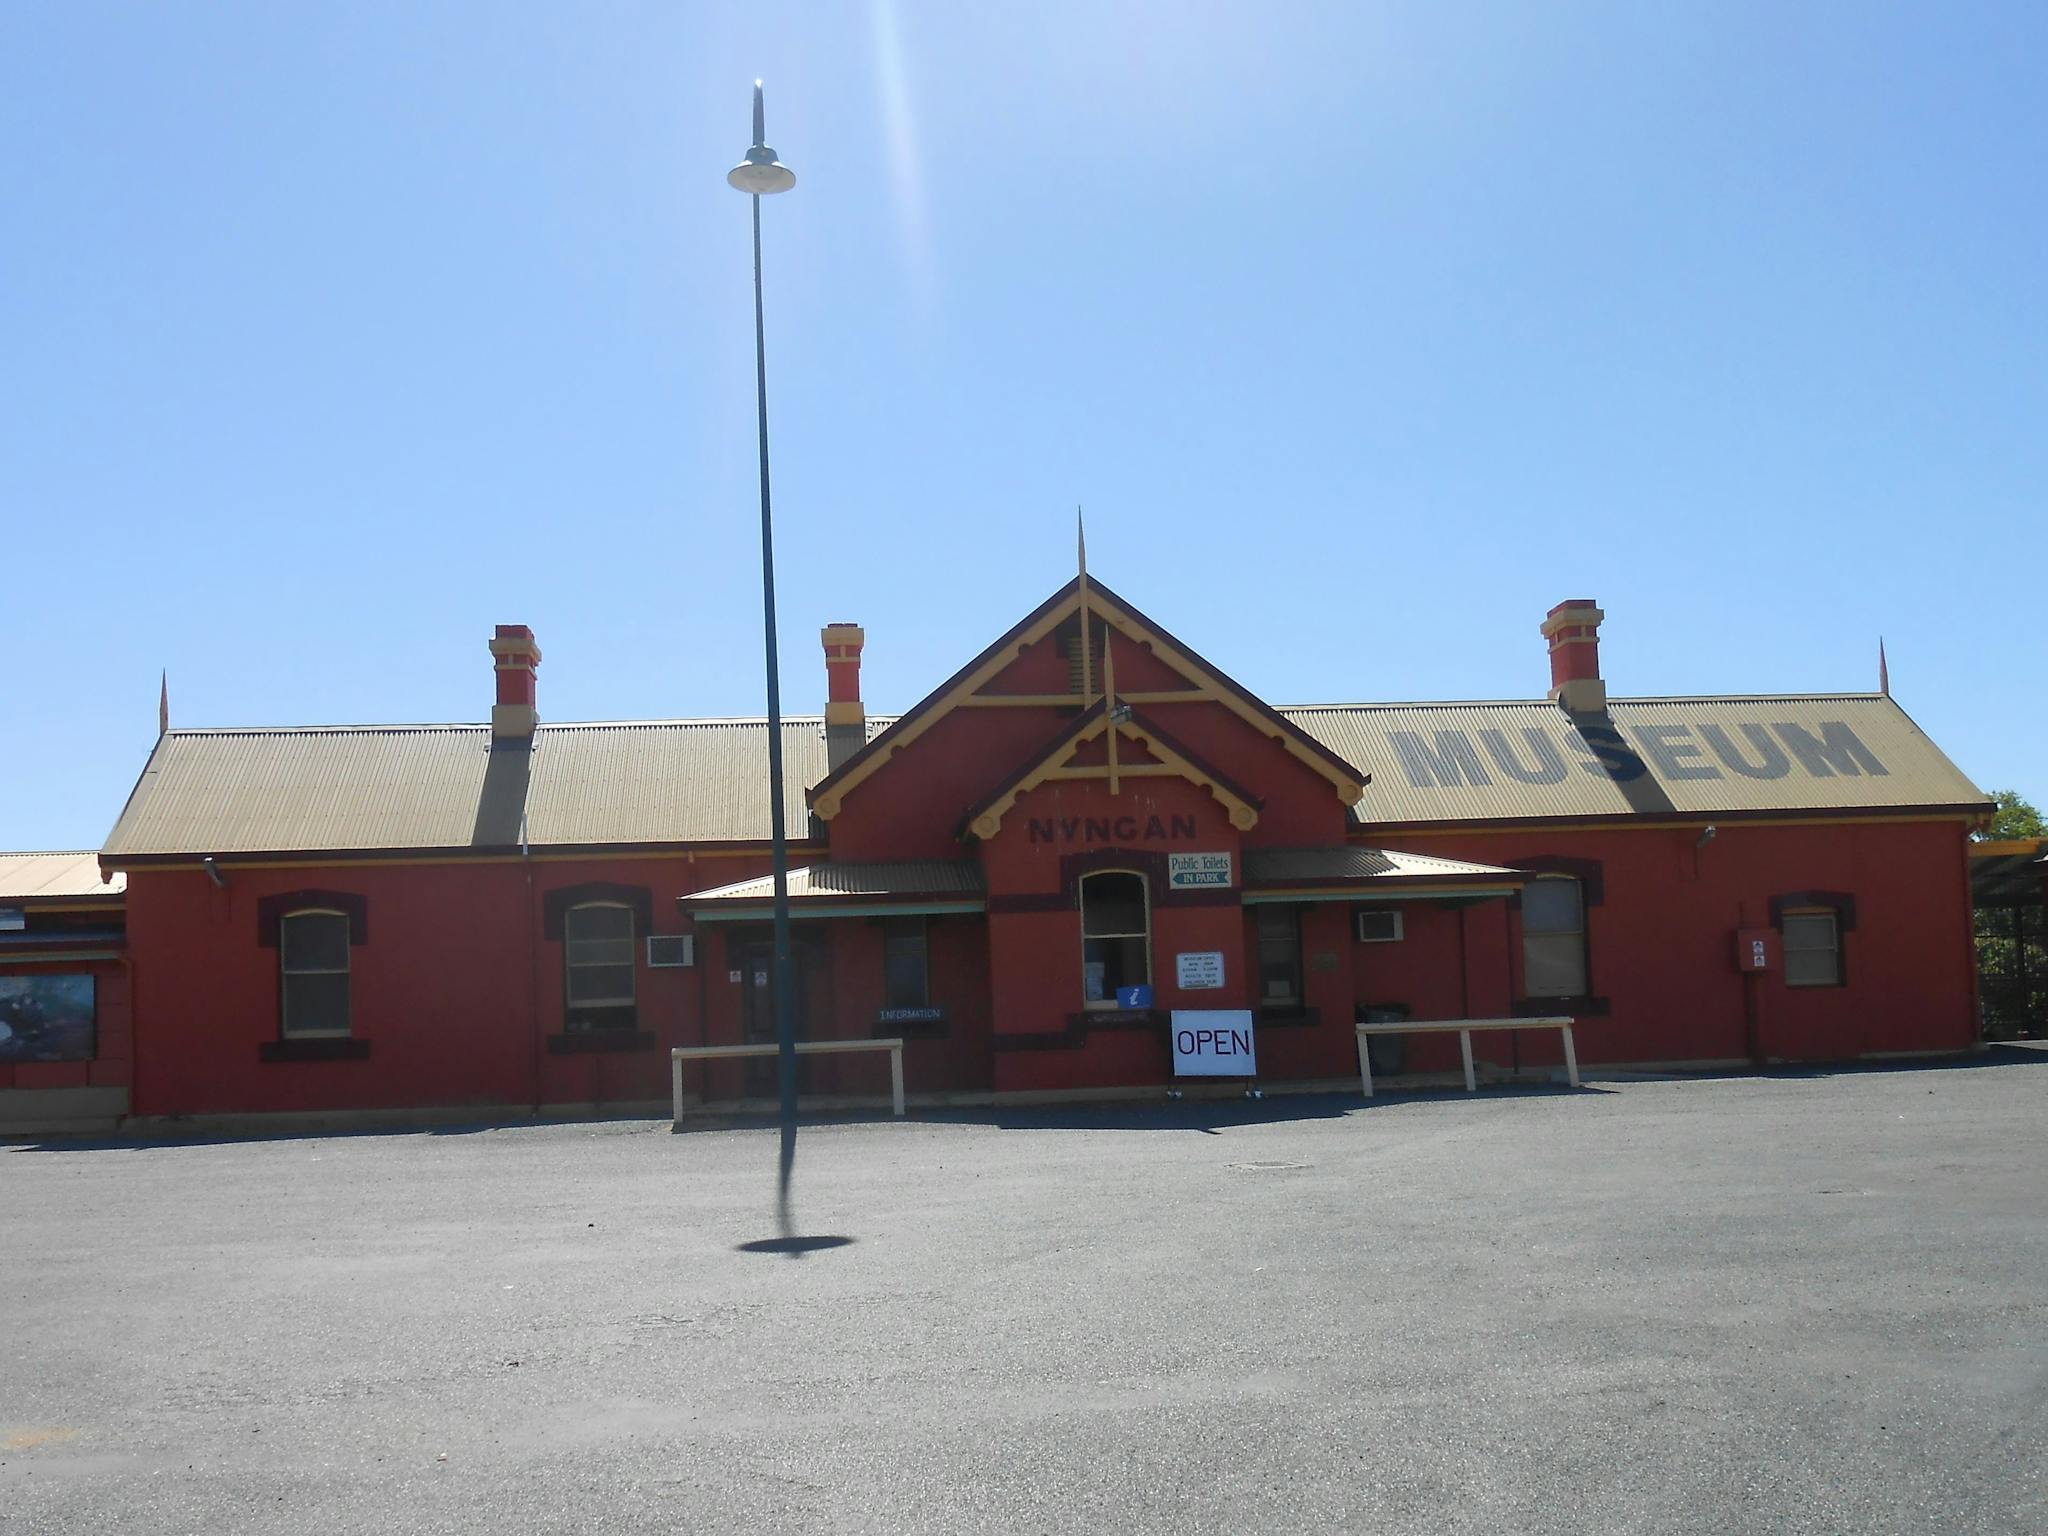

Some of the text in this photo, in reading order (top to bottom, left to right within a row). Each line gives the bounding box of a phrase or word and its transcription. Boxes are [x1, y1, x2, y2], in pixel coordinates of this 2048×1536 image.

[1385, 721, 1889, 788] MUSEUM
[1029, 815, 1196, 842] NYNGAN
[1171, 856, 1229, 870] Public Toilets
[1183, 873, 1219, 883] IN PARK
[879, 1009, 941, 1020] INFORMATION
[1177, 1030, 1250, 1055] OPEN
